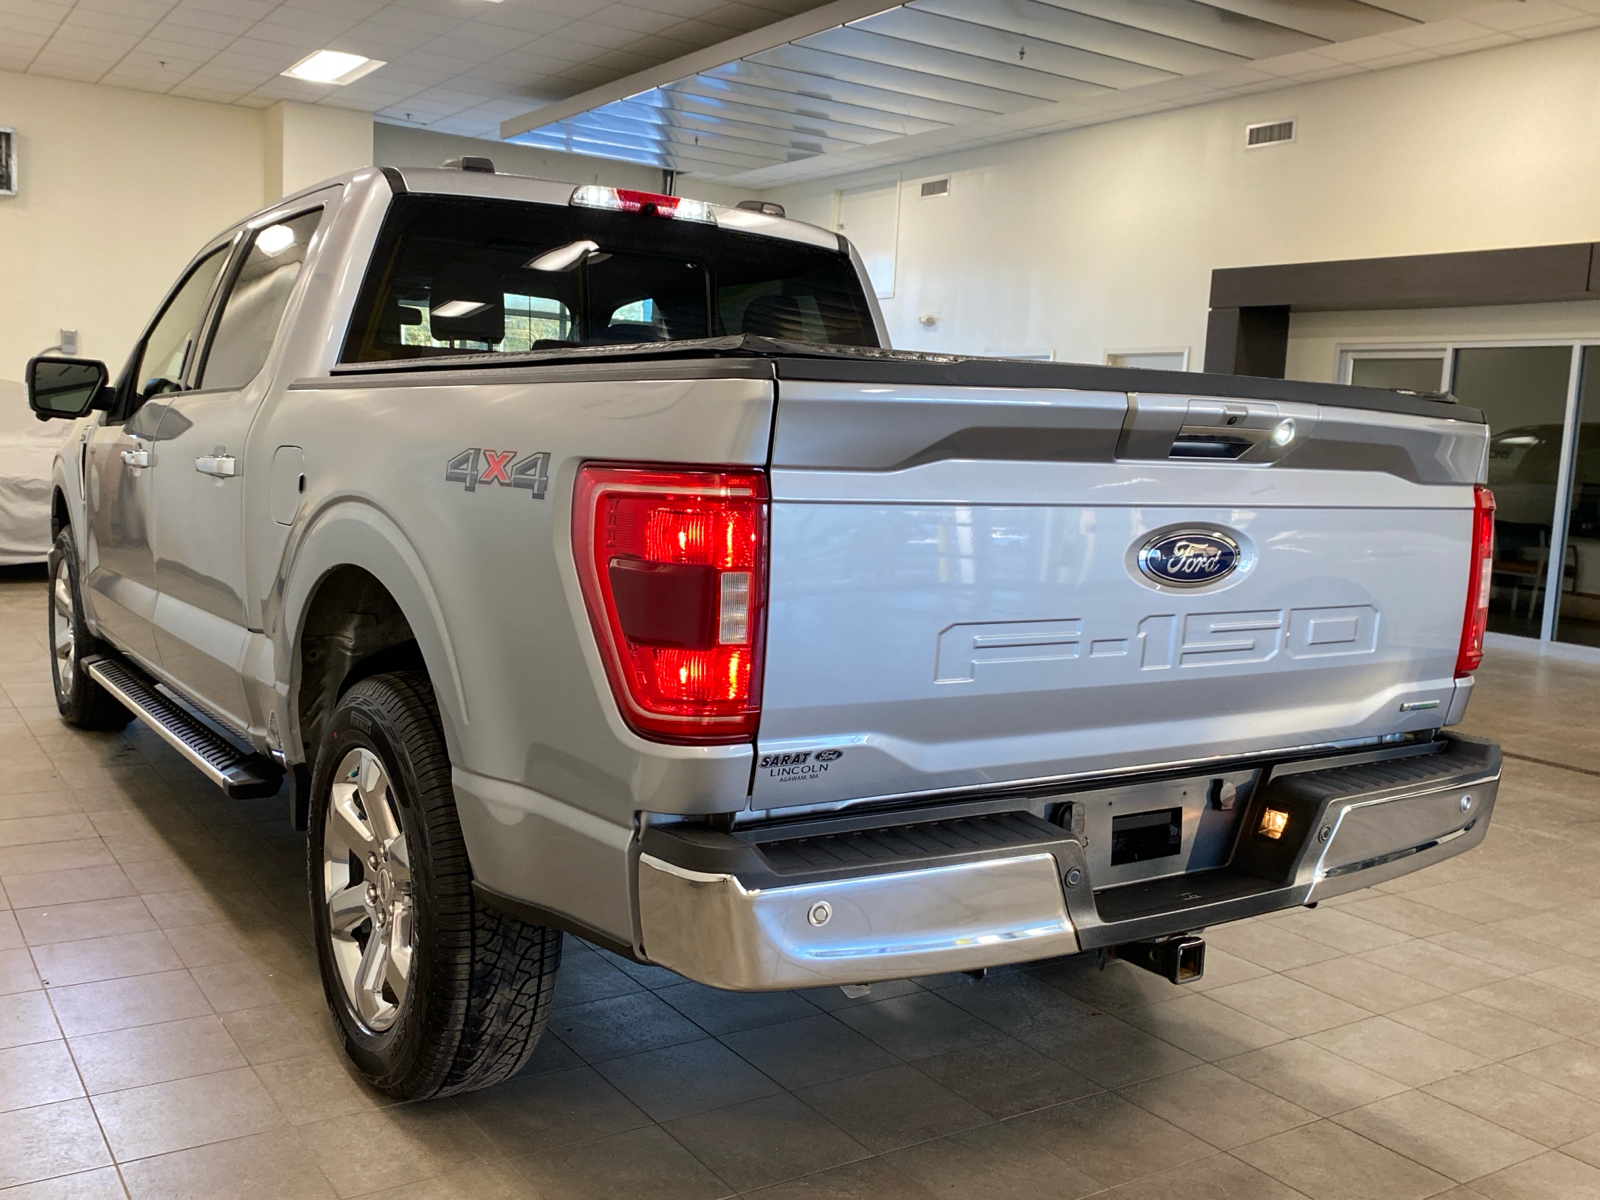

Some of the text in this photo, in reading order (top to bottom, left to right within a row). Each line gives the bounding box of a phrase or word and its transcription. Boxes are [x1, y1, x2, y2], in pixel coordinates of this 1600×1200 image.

[1167, 541, 1222, 573] Ford
[933, 603, 1381, 684] F-150
[760, 750, 840, 768] SARAT Ford
[770, 763, 829, 777] LINCOLN
[779, 774, 808, 783] AGAWAM,
